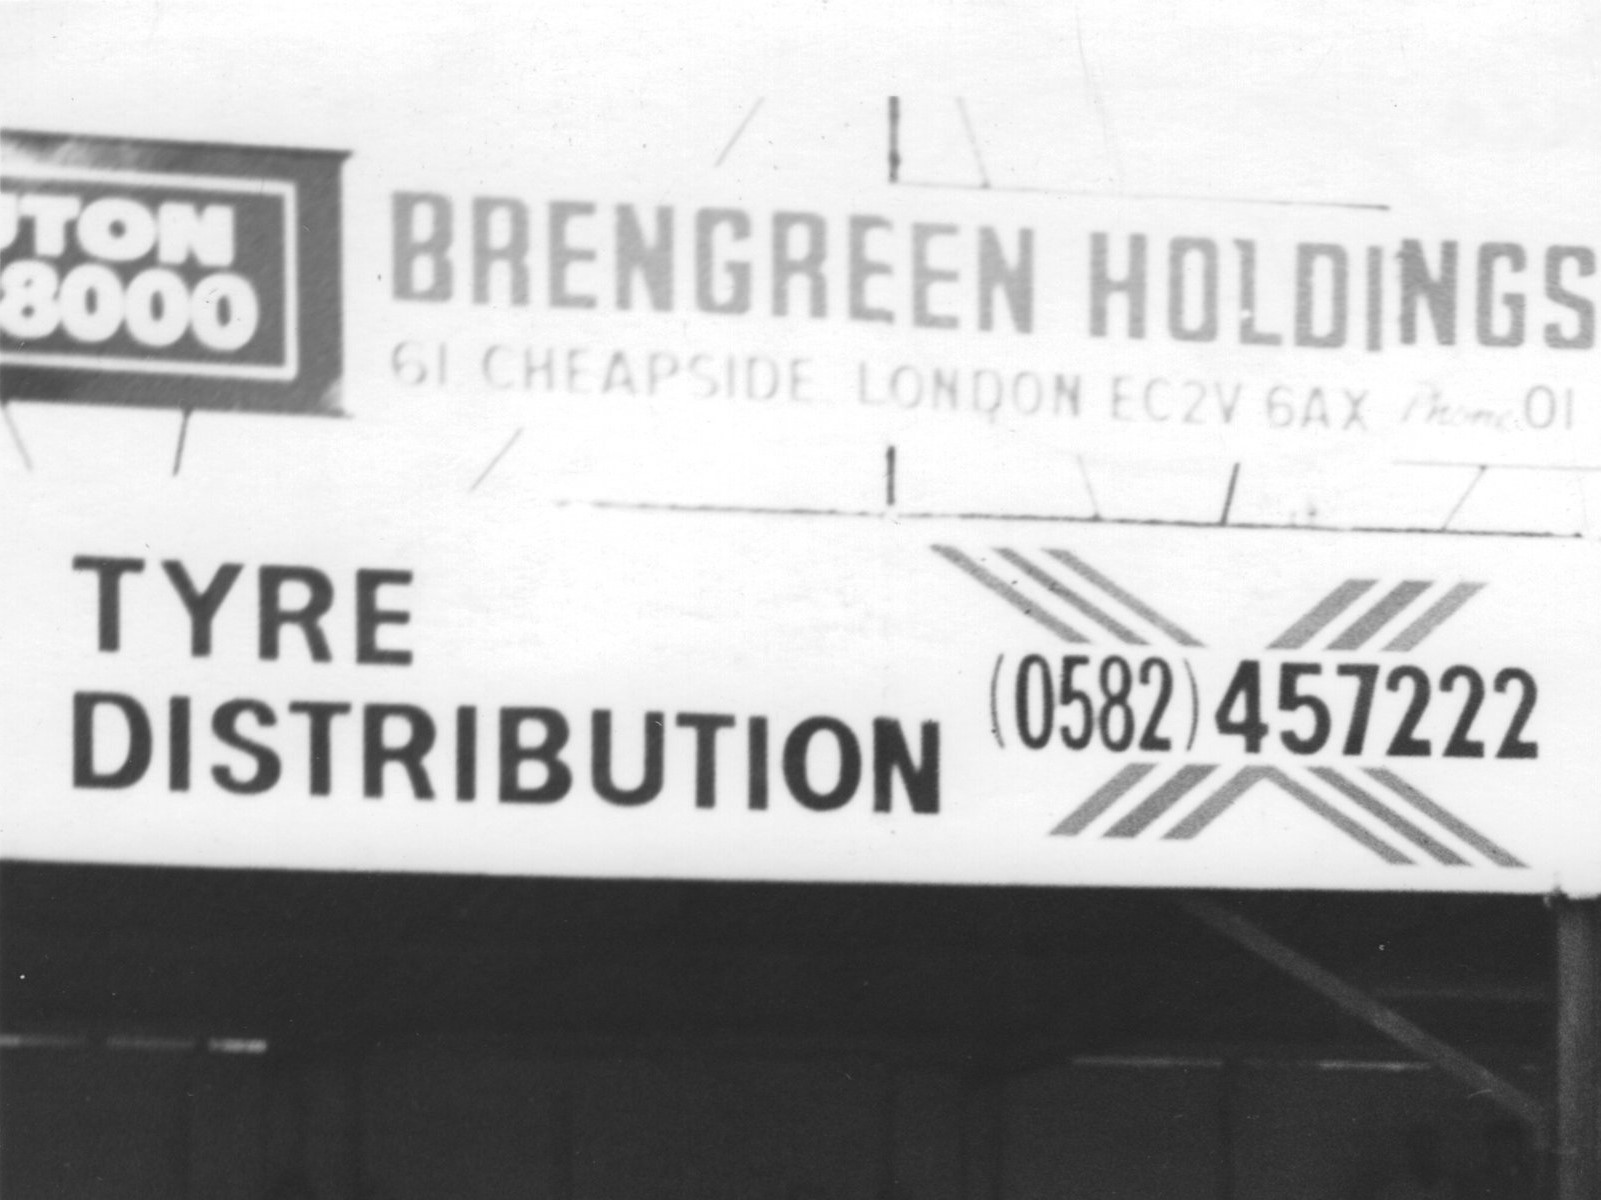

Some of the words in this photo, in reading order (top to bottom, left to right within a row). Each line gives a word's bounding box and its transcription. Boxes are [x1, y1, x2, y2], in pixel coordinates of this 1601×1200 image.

[0, 258, 260, 352] 8000
[390, 191, 1035, 335] BRENGREEN
[1089, 231, 1597, 353] HOLDINGS
[482, 343, 816, 403] CHEAPSIDE
[858, 362, 1083, 420] LONDON
[1111, 374, 1243, 425] EC2V
[1266, 385, 1370, 431] 6AX
[71, 554, 414, 666] TYRE
[71, 690, 942, 815] DISTRIBUTION
[989, 653, 1200, 753] (0582)
[1213, 659, 1540, 761] 457222
